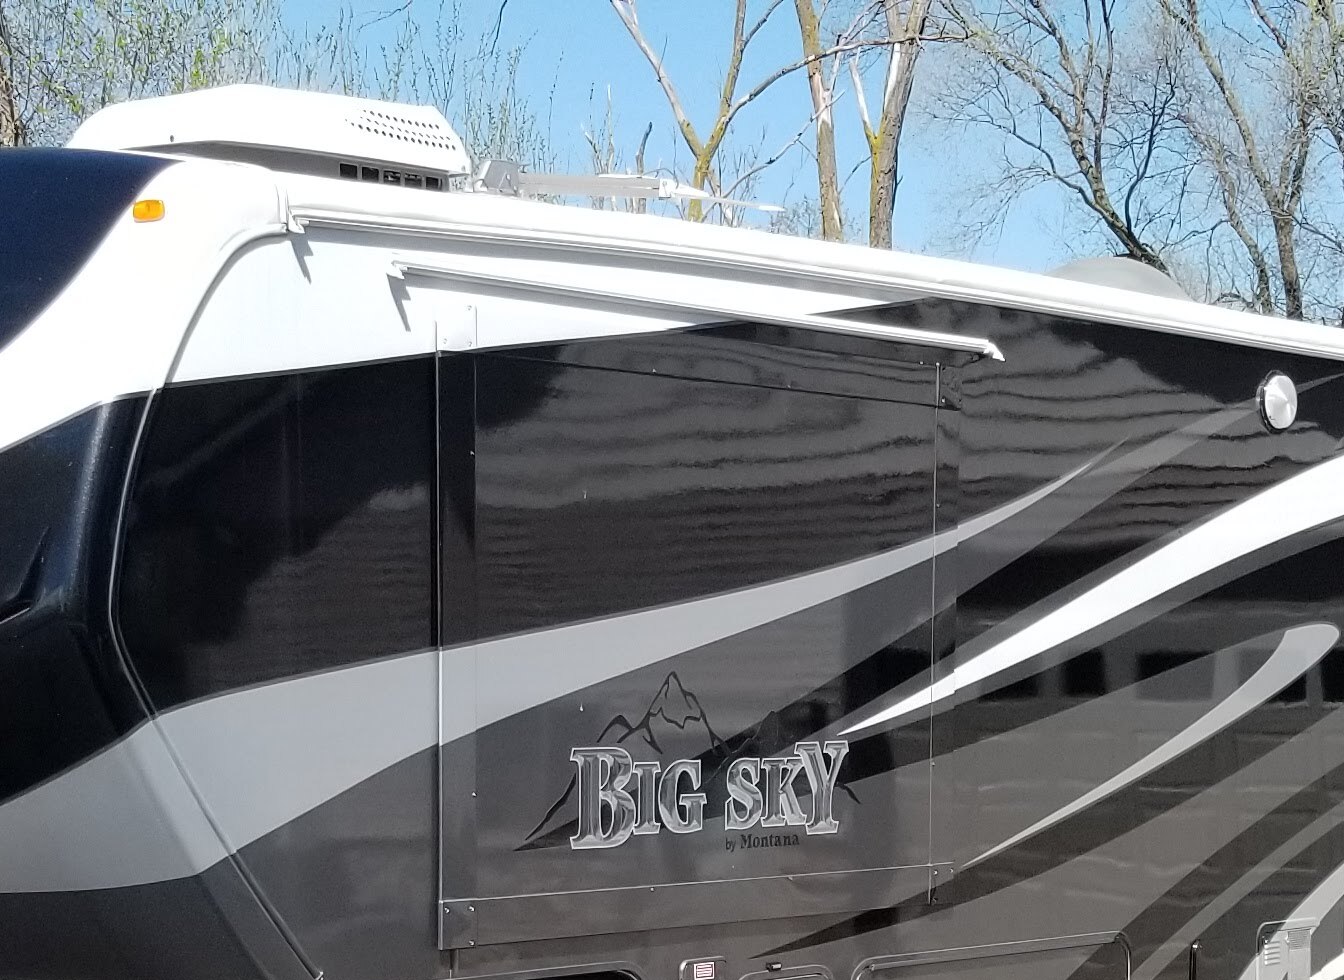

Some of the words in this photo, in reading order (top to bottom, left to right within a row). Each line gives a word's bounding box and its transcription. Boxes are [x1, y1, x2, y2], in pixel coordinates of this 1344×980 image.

[568, 746, 708, 851] BIG
[723, 739, 850, 836] SKY
[725, 837, 736, 853] by
[740, 833, 800, 849] Montana
